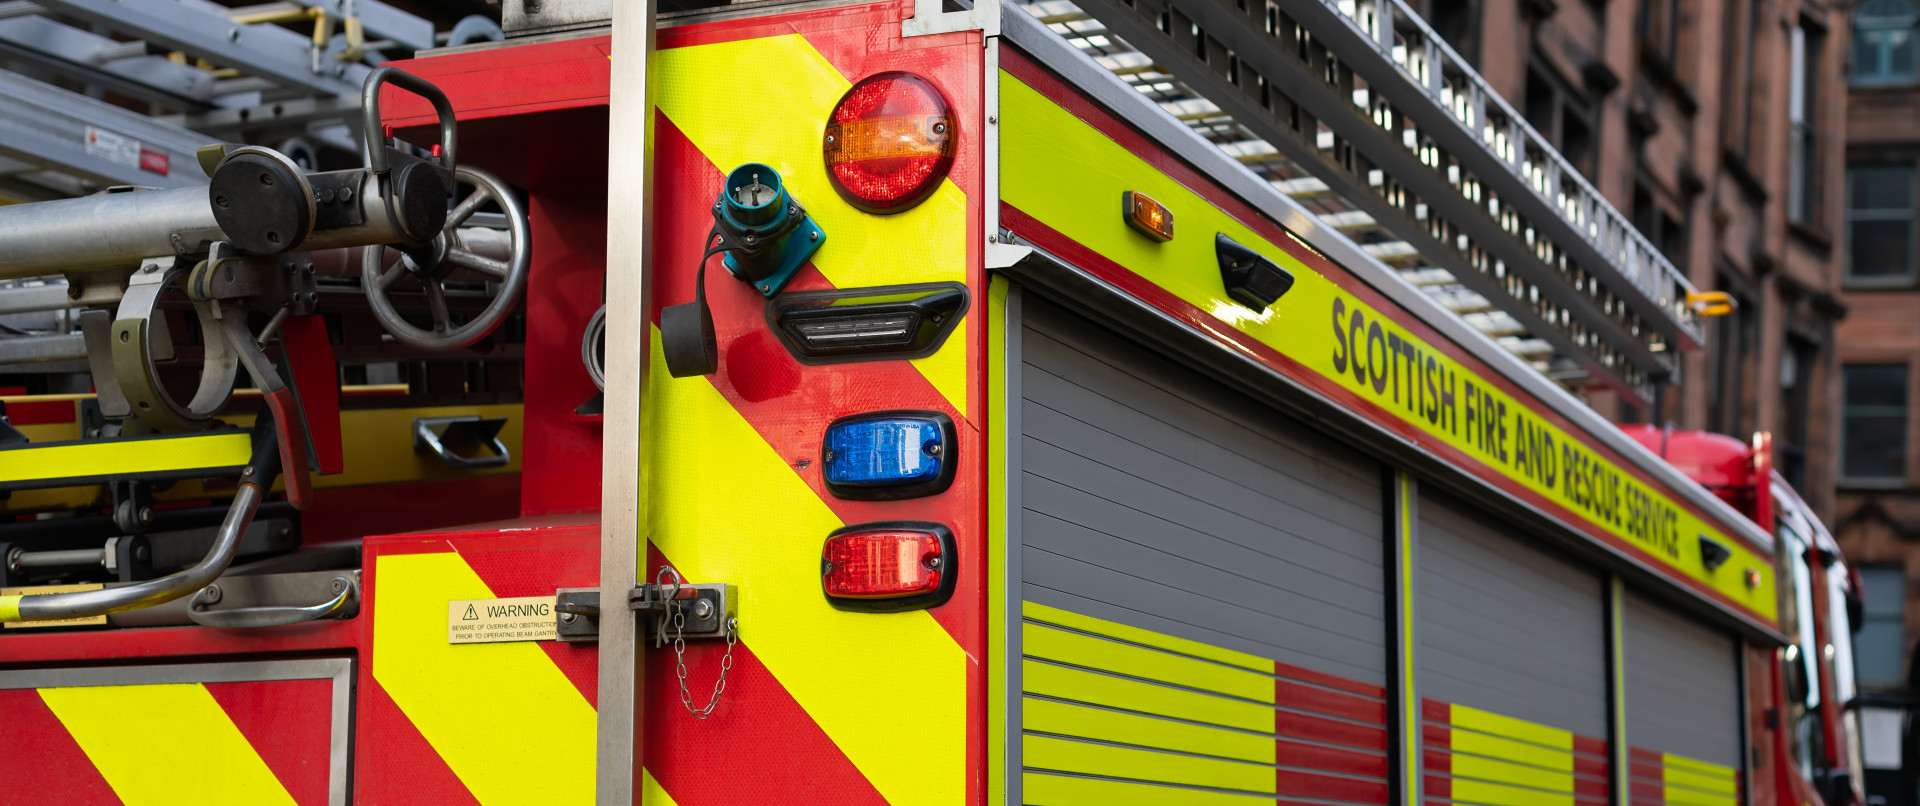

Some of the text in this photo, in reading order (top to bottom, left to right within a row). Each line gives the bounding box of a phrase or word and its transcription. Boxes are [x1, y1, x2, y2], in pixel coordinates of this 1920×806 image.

[1333, 296, 1680, 560] SCOTTISH FIRE AND RESCUE SERVICE
[487, 603, 549, 618] WARNING
[484, 631, 515, 639] OPERATING
